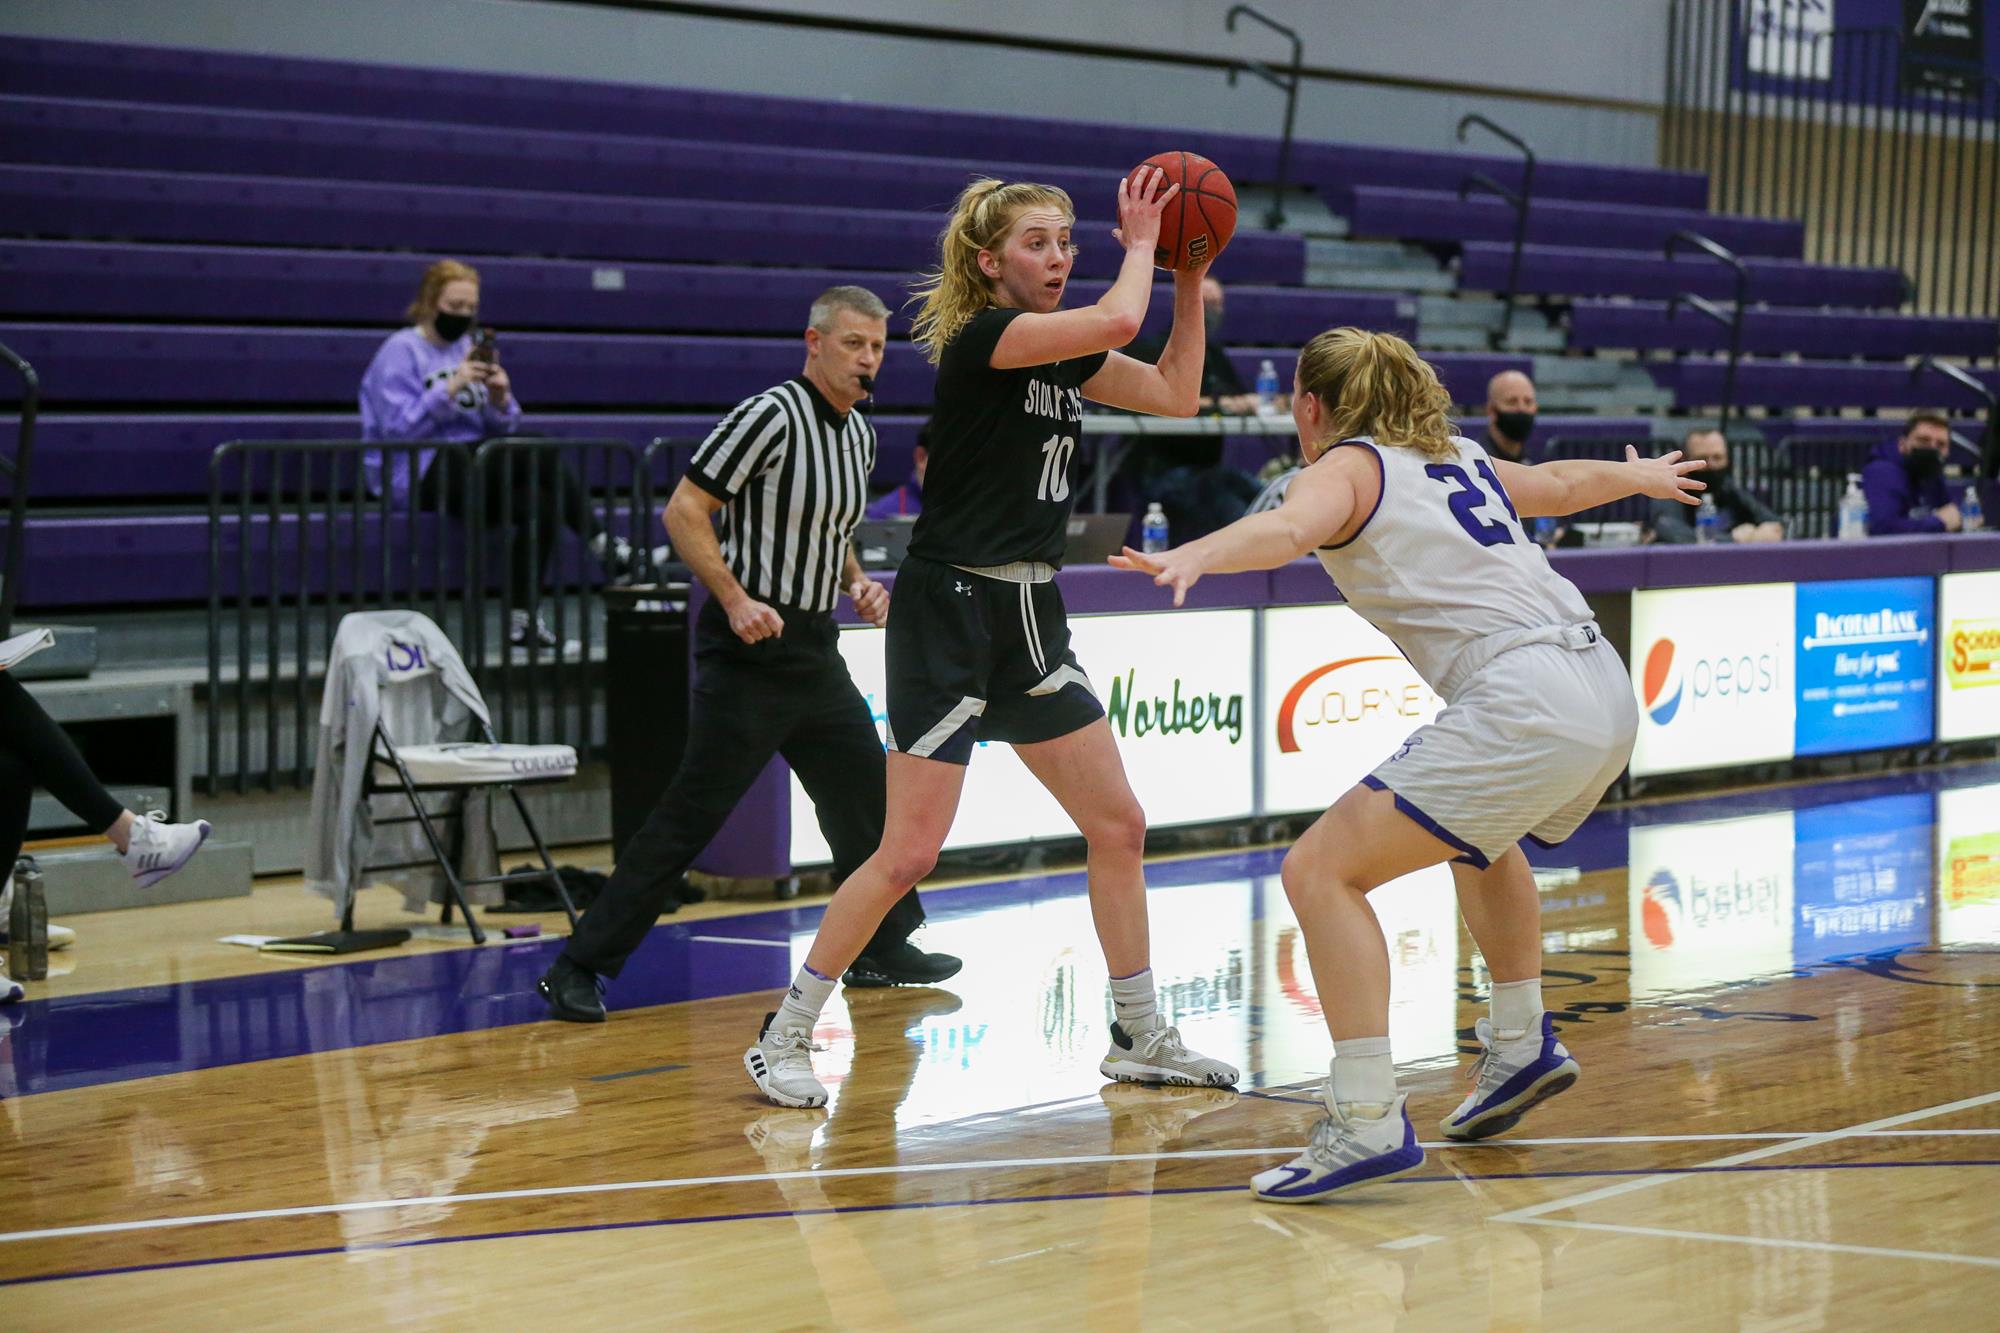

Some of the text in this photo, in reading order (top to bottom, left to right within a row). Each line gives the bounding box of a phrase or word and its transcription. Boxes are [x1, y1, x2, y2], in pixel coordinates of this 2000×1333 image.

[1037, 433, 1075, 502] 10
[1424, 458, 1520, 548] 21
[1881, 608, 1918, 634] BANK
[1108, 667, 1244, 744] Norberg
[1304, 684, 1435, 726] JOURNE
[1692, 641, 1781, 712] pepsi
